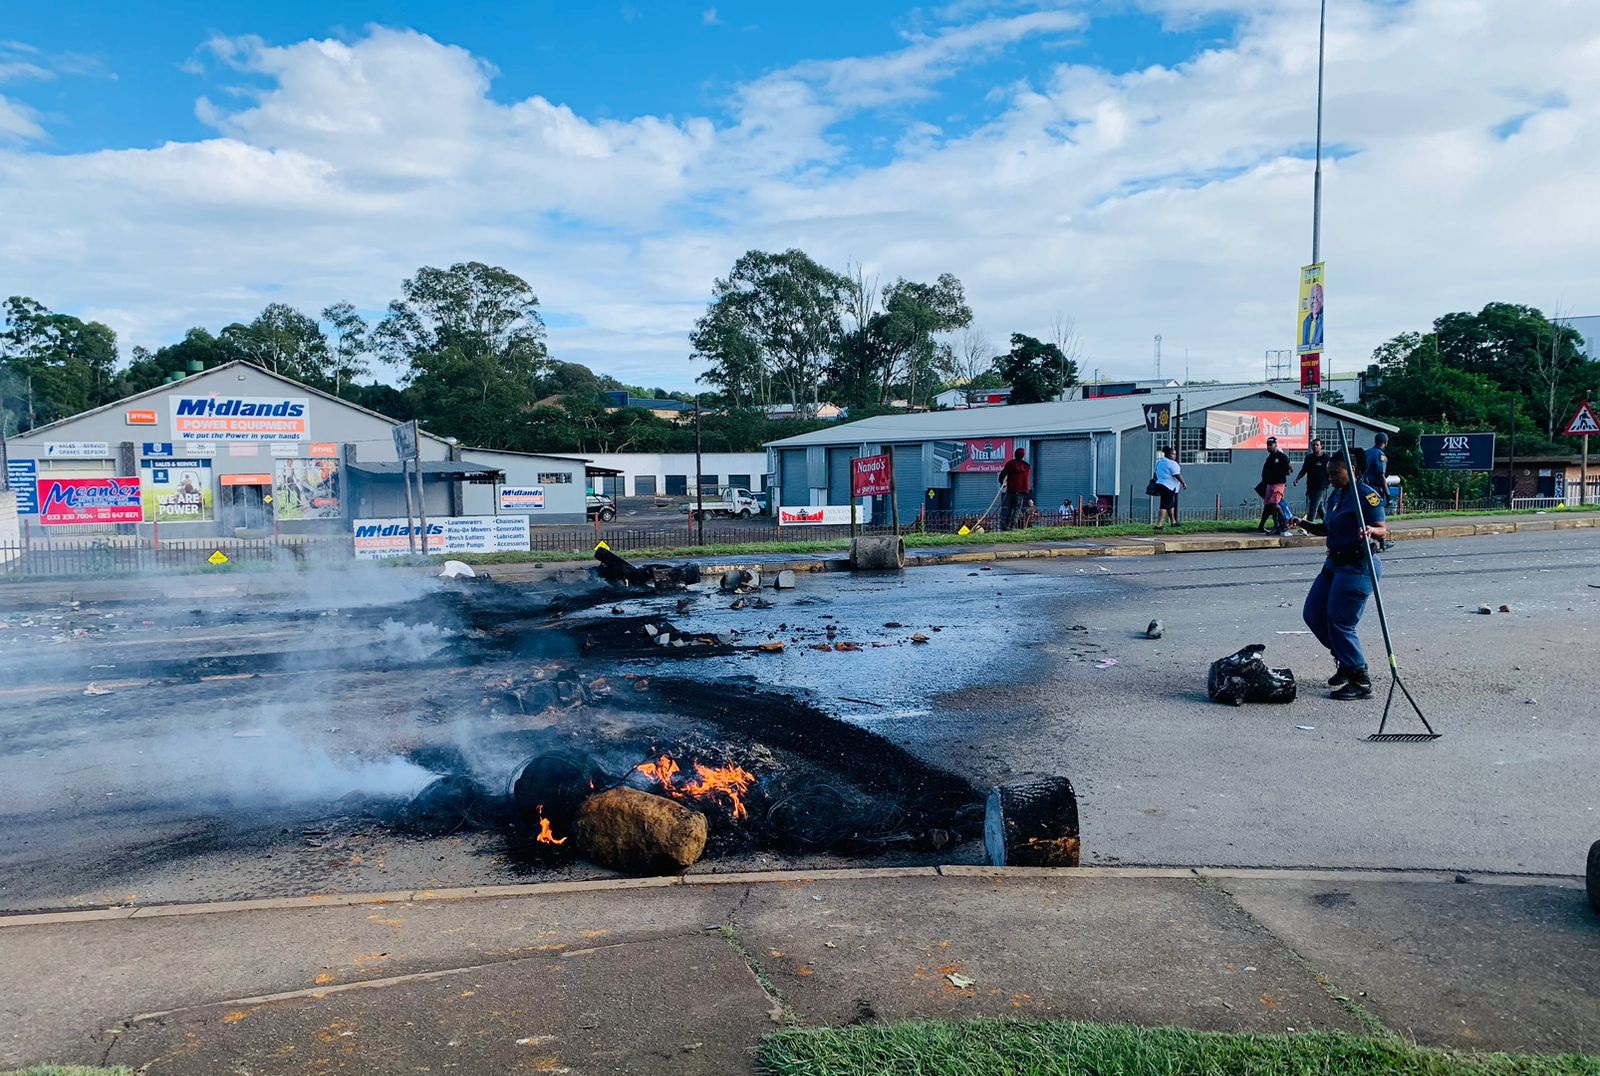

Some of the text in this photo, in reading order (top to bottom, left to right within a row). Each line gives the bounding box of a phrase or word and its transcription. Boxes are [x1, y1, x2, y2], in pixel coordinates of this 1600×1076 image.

[176, 398, 305, 417] Midlands
[130, 412, 154, 420] STIHL
[183, 420, 298, 431] POWER EQUIPMENT
[197, 432, 209, 440] put
[260, 433, 277, 441] your
[971, 441, 1006, 460] STEEL MAN
[857, 459, 886, 472] Nando's
[41, 479, 140, 516] Meander
[157, 493, 200, 504] WE ARE
[159, 504, 199, 514] POWER
